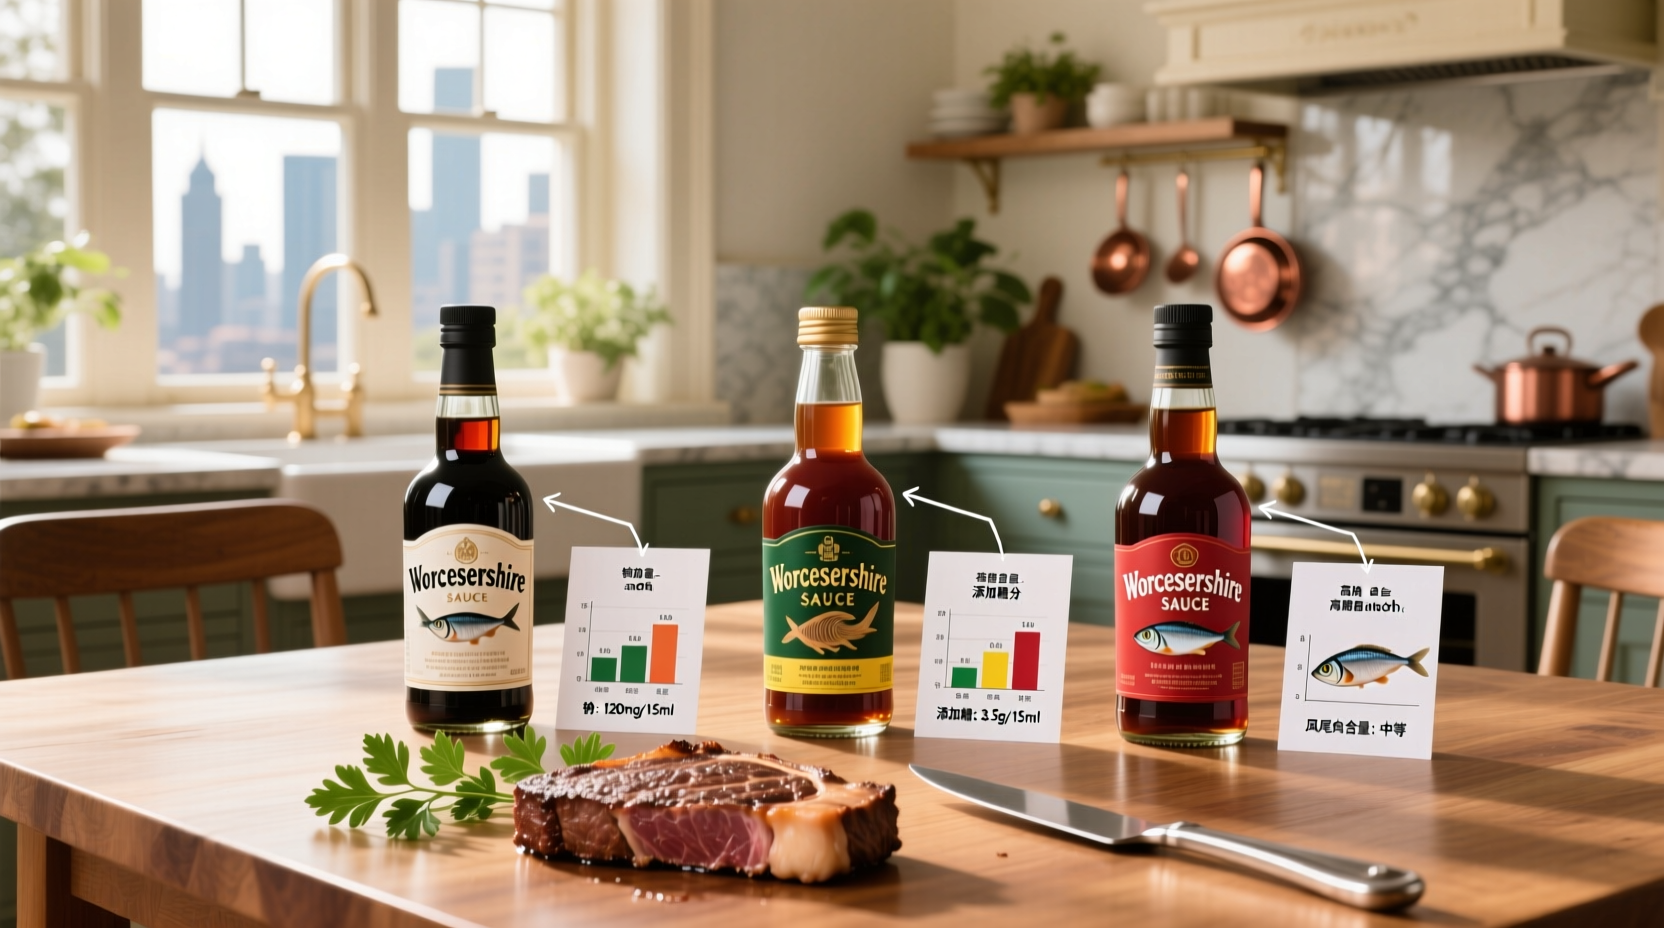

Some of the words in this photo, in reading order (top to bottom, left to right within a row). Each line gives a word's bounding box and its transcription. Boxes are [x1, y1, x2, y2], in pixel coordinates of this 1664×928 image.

[408, 561, 526, 594] Worcesershire
[769, 562, 888, 595] Worcesershire
[1122, 568, 1243, 603] Worcesershire
[446, 592, 488, 603] SAUCE
[800, 592, 855, 606] SAUCE
[1161, 596, 1210, 611] SAUCE
